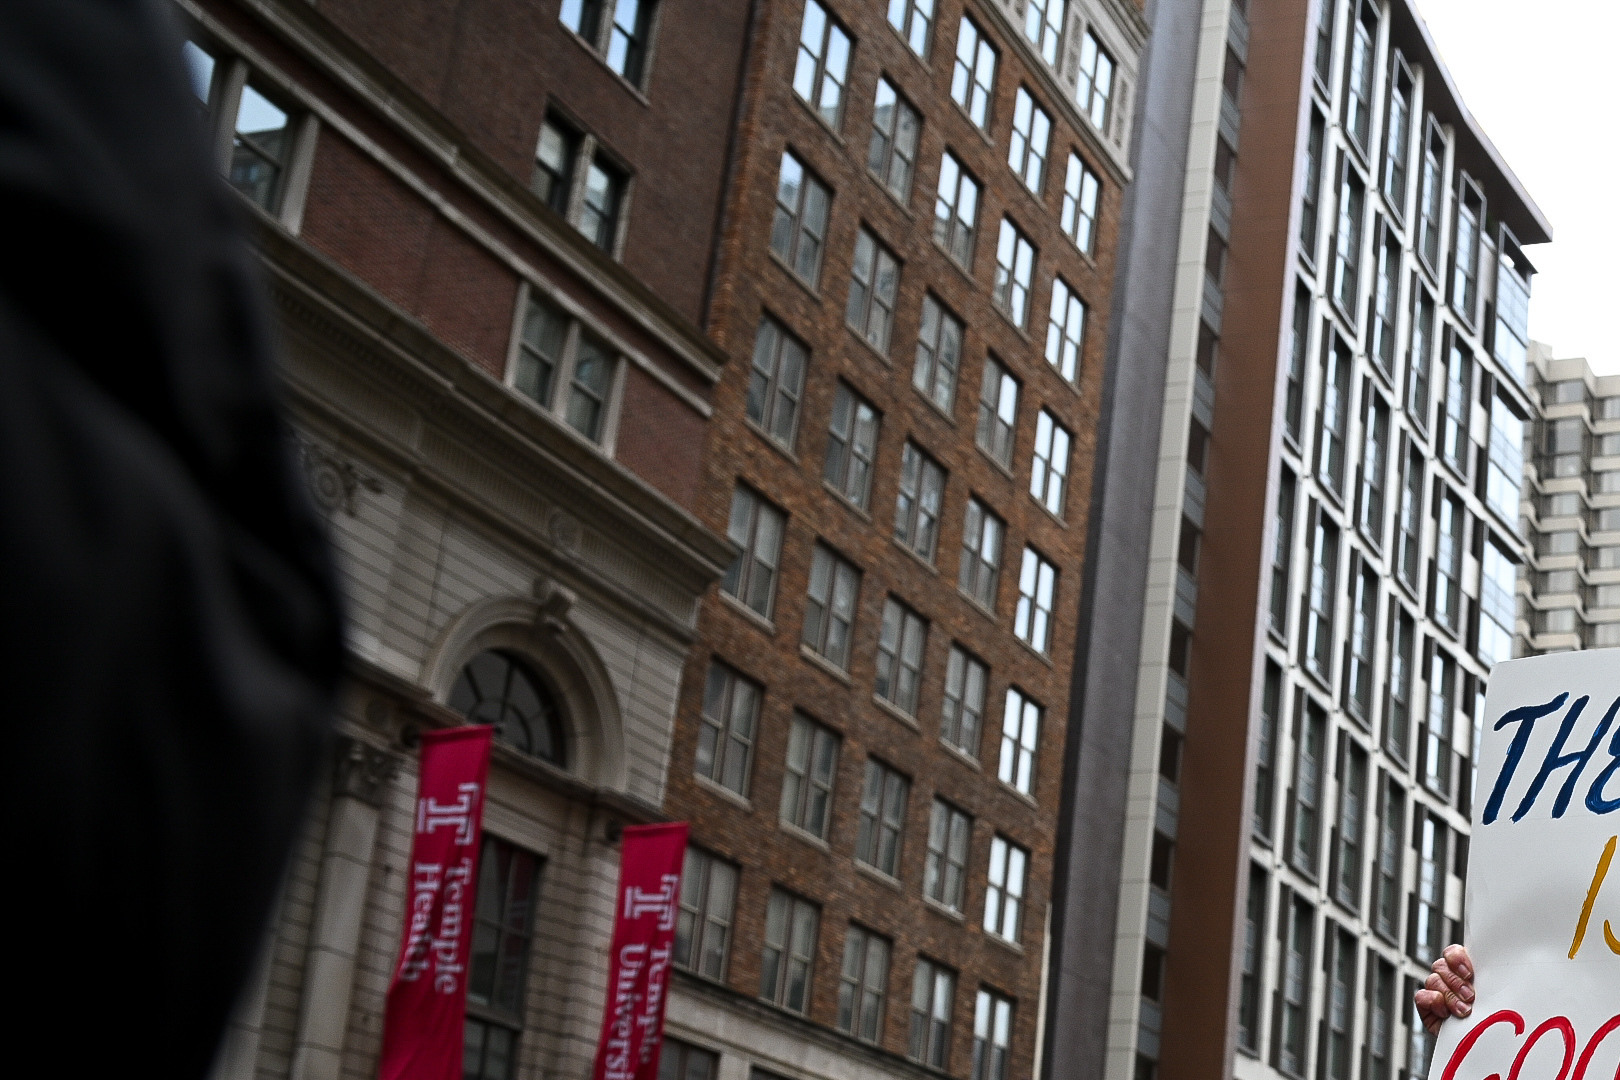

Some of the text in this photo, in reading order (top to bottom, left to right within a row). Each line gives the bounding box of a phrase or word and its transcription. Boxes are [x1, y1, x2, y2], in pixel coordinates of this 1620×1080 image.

[398, 861, 442, 981] Health
[430, 857, 473, 995] Temple
[637, 941, 673, 1065] Temple
